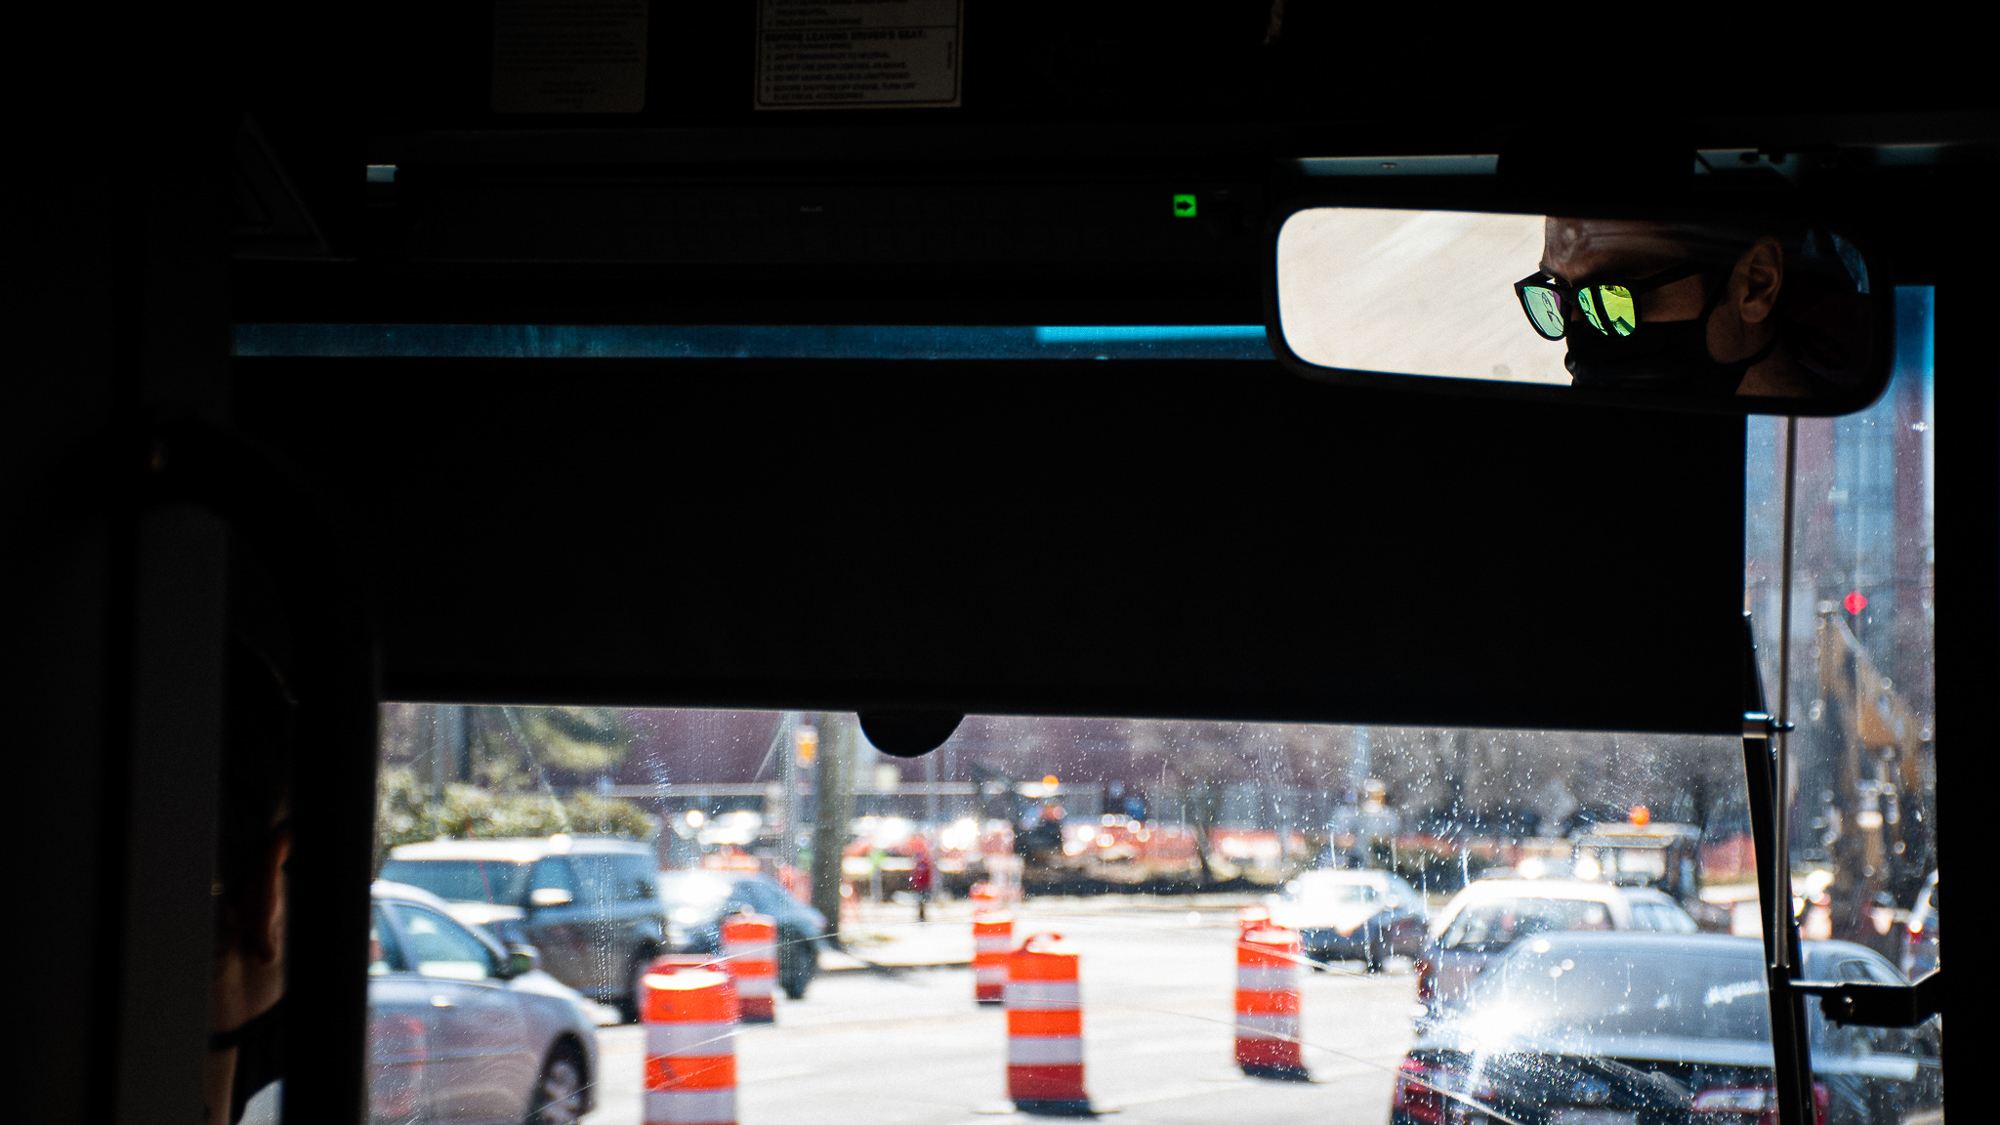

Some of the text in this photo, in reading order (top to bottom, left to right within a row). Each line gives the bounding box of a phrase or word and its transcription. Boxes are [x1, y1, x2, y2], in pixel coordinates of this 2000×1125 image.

[765, 32, 803, 42] BEFORE
[806, 31, 848, 42] LEAVING
[851, 30, 895, 41] DRIVER'S
